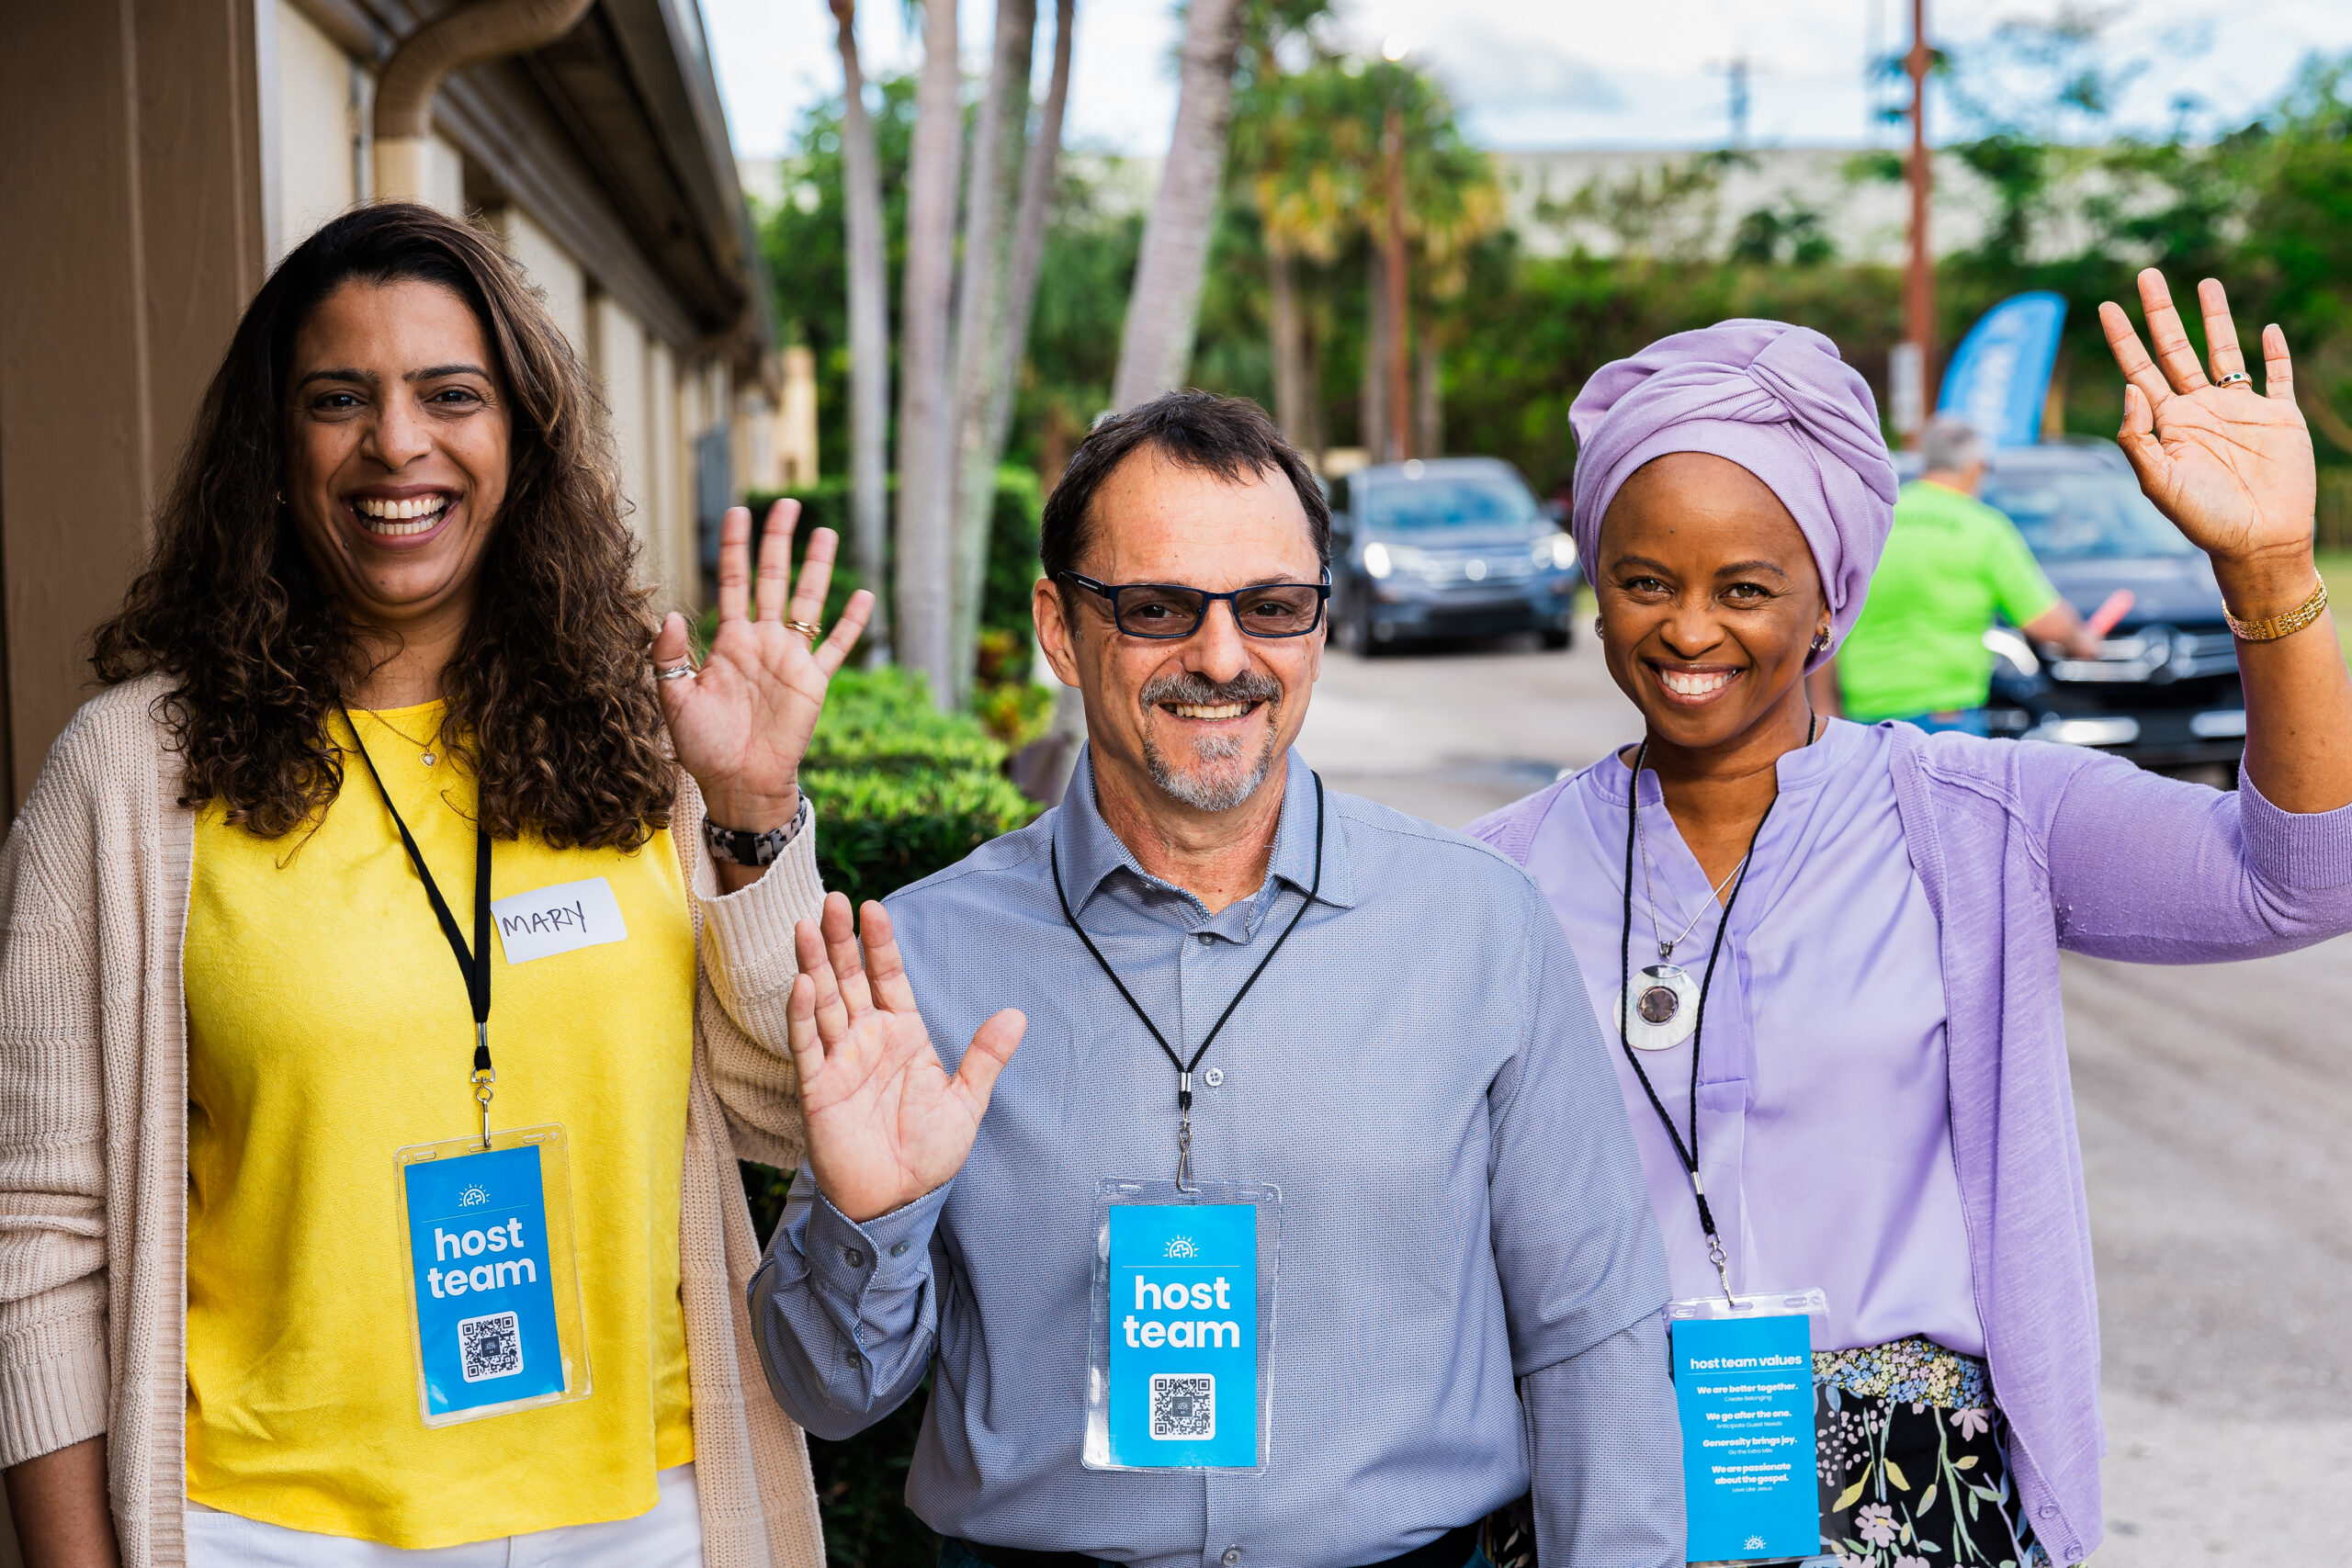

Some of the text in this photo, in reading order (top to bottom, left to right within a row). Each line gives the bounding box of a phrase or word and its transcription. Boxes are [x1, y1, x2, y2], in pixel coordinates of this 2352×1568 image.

[502, 900, 587, 937] MARY
[435, 1217, 525, 1262] host
[427, 1258, 537, 1299] team
[1135, 1275, 1230, 1311] host
[1123, 1314, 1240, 1348] team
[1690, 1354, 1803, 1370] host team values
[1697, 1382, 1799, 1394] We are better together.
[1706, 1410, 1792, 1423] We go after the one.
[1702, 1435, 1798, 1449] Generosity brings joy.
[1712, 1462, 1792, 1475] We are passionate
[1714, 1473, 1790, 1485] about the gospel.
